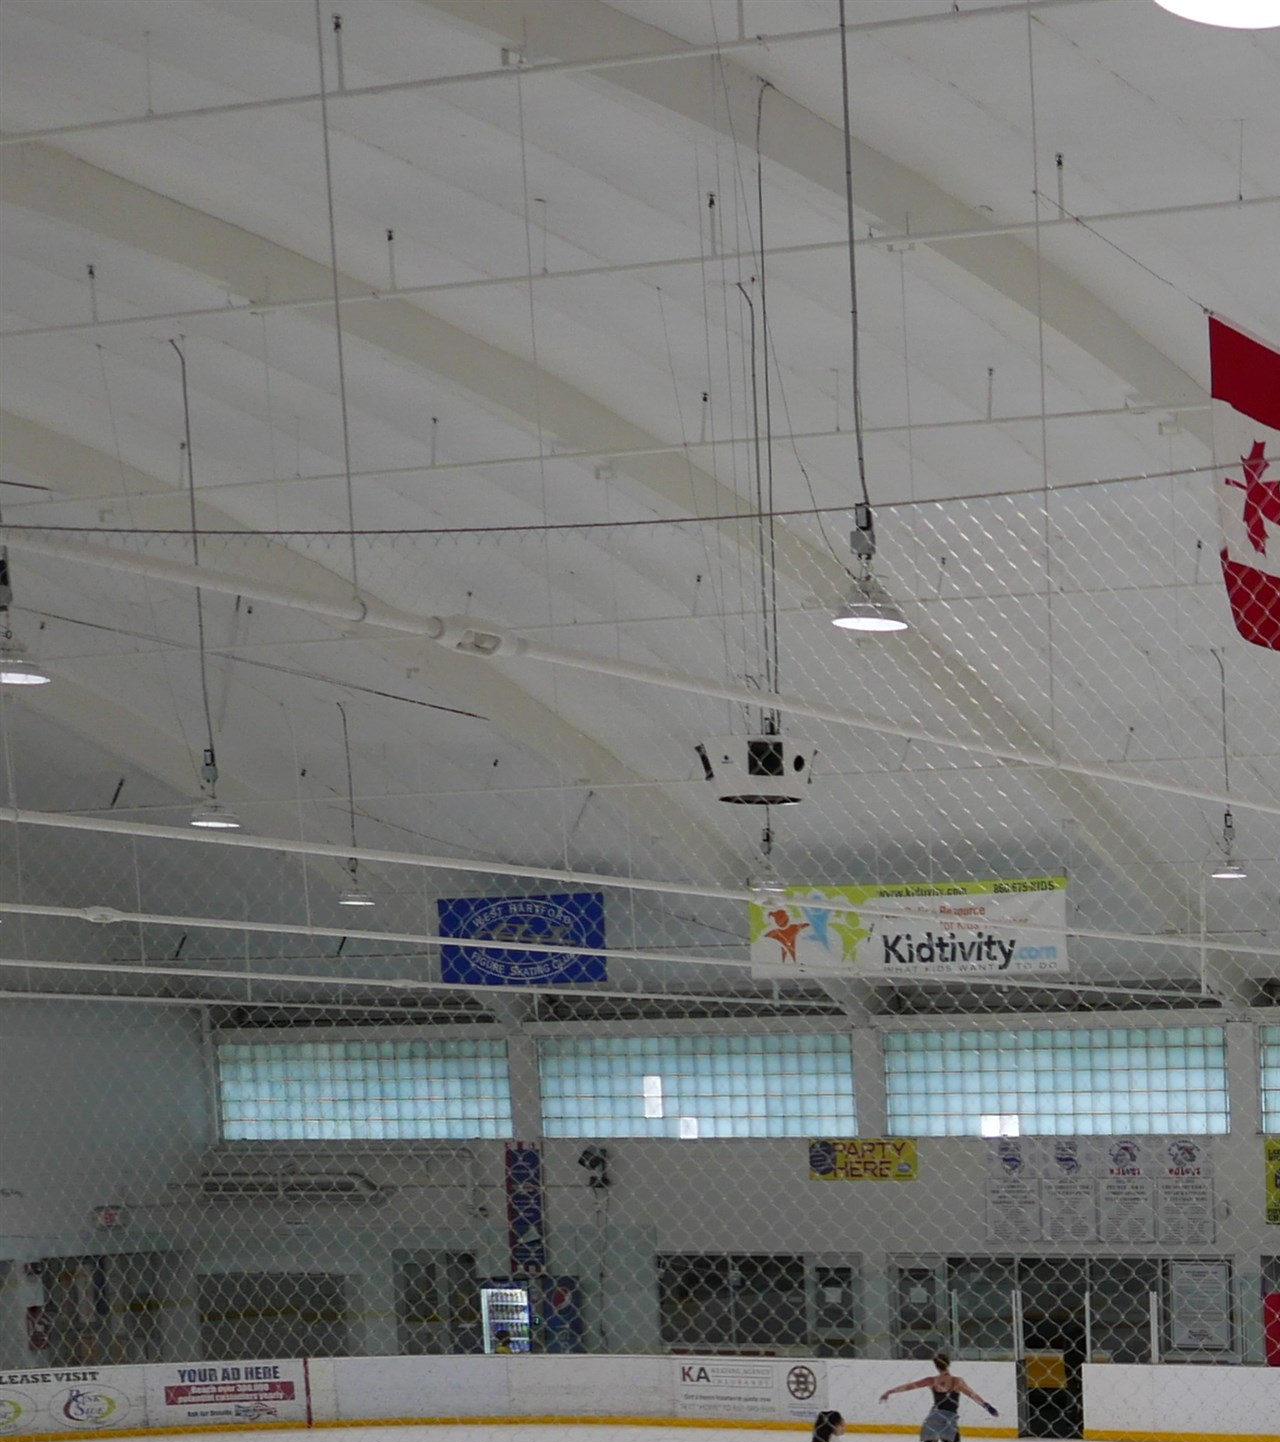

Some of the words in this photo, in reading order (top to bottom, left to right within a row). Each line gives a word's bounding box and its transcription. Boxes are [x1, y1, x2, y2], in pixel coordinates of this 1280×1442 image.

[472, 906, 502, 927] WEST
[509, 904, 572, 924] HARTFORD
[471, 951, 505, 974] FIGURE
[510, 965, 550, 977] SKATING
[925, 964, 951, 973] KIDS
[959, 963, 993, 972] WANT
[1015, 961, 1032, 970] TO
[1038, 961, 1058, 970] DO
[833, 1142, 907, 1159] PARTY
[833, 1161, 892, 1178] HERE
[0, 1373, 51, 1385] LEASE
[53, 1371, 99, 1381] VISIT
[177, 1368, 219, 1382] YOUR
[221, 1367, 240, 1380] AD
[244, 1366, 280, 1380] HERE
[681, 1366, 711, 1383] KA
